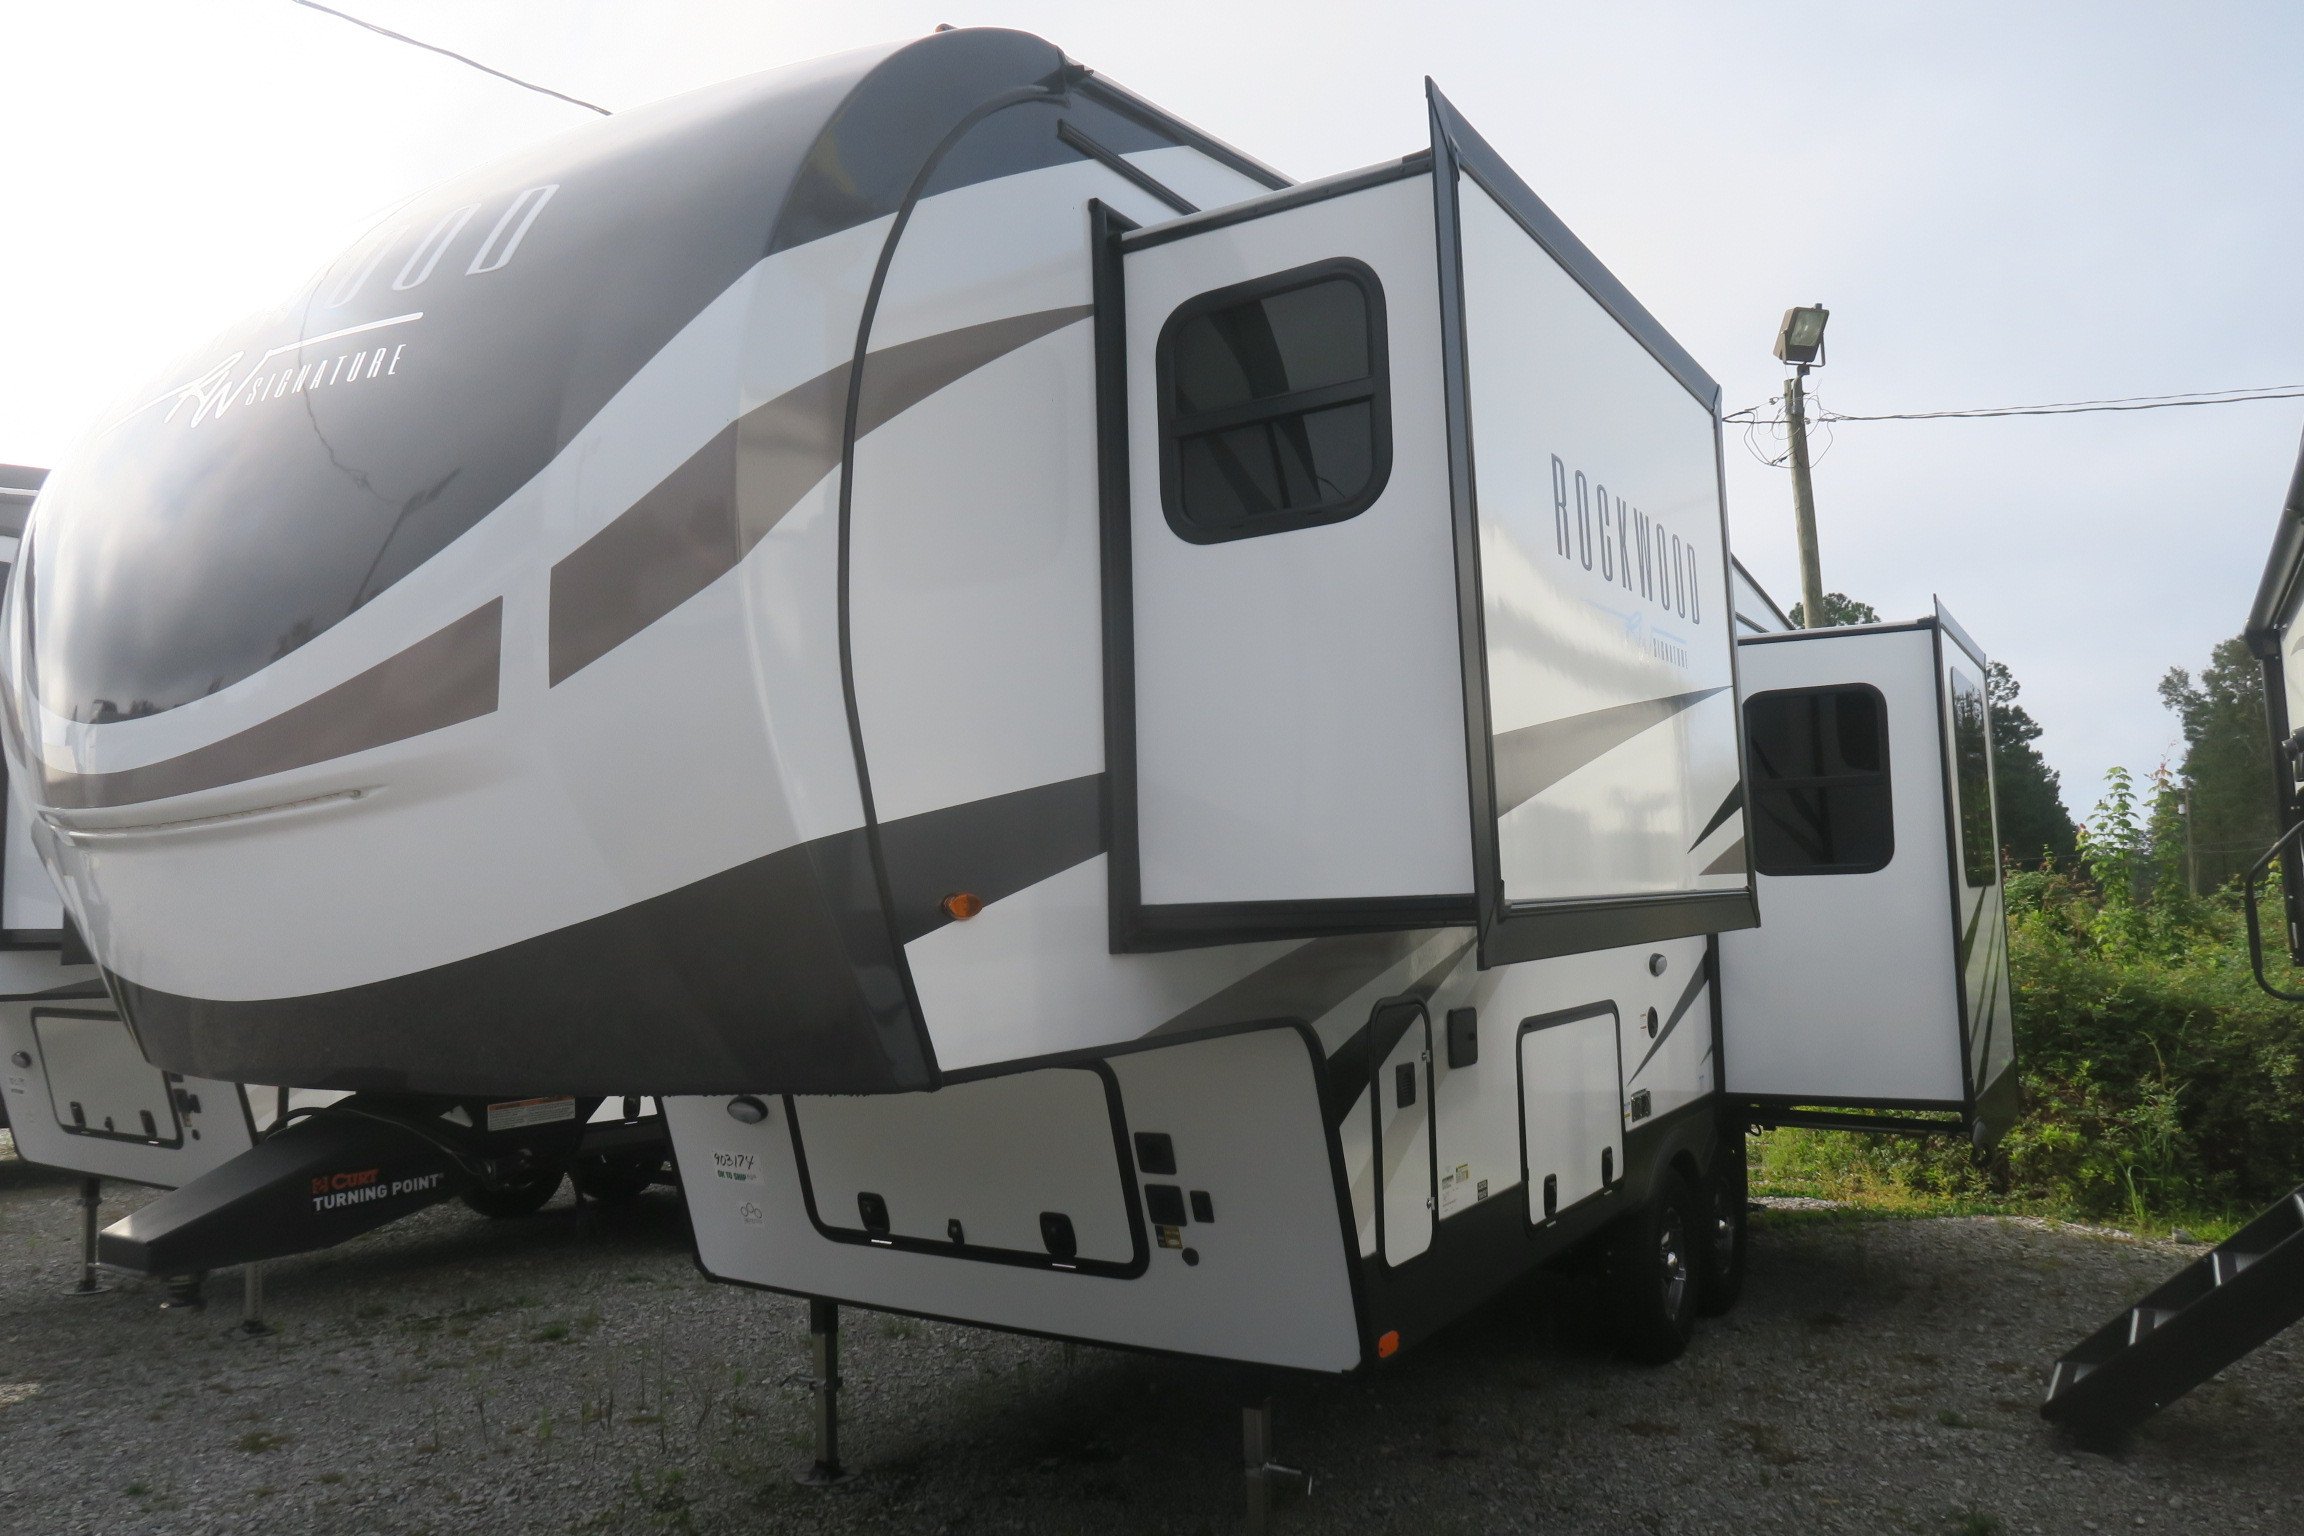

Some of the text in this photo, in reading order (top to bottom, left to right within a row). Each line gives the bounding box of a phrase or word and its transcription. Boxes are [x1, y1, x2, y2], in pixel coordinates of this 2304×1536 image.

[245, 343, 407, 406] SIGNATURE
[1551, 452, 1700, 625] ROCKWOOD
[312, 1173, 440, 1212] TURNING POINT
[331, 1168, 380, 1190] CURT
